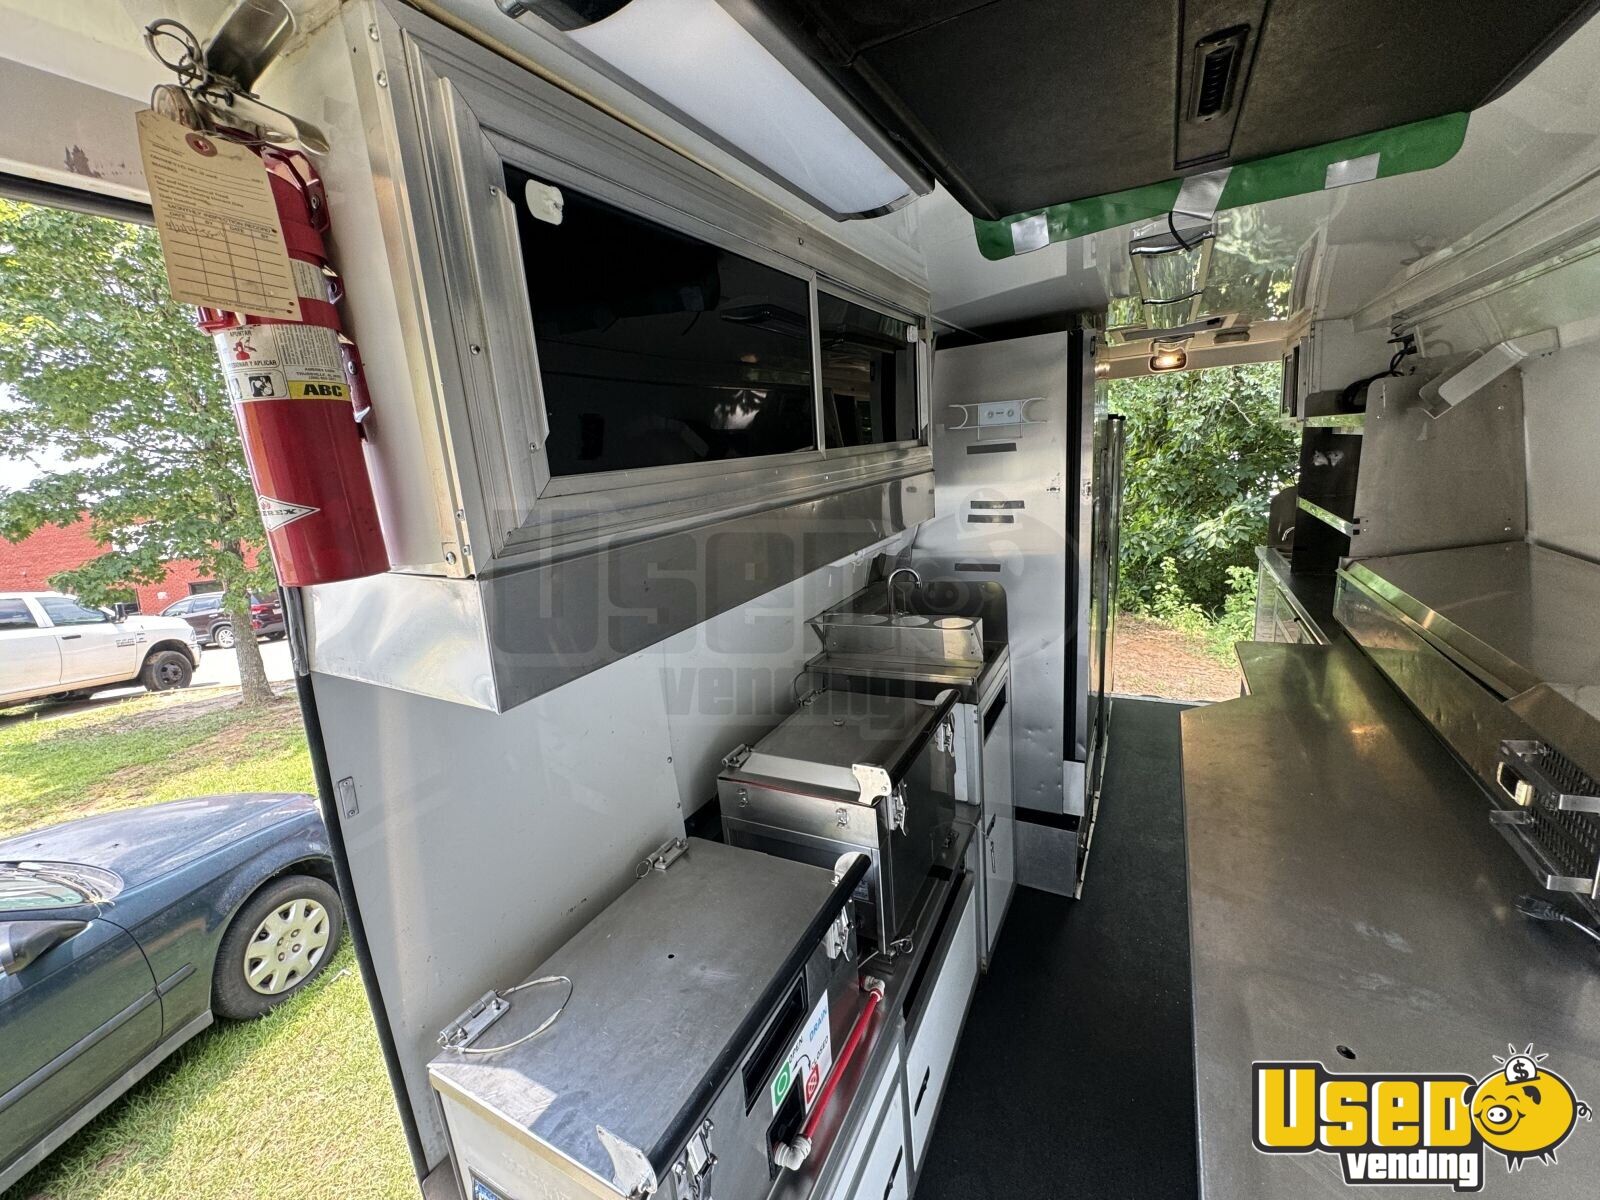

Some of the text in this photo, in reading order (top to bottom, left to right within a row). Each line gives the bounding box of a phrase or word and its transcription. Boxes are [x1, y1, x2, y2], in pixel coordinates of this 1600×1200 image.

[303, 383, 343, 397] ABC
[809, 1008, 828, 1042] DRAIN
[788, 1035, 803, 1064] OPEN
